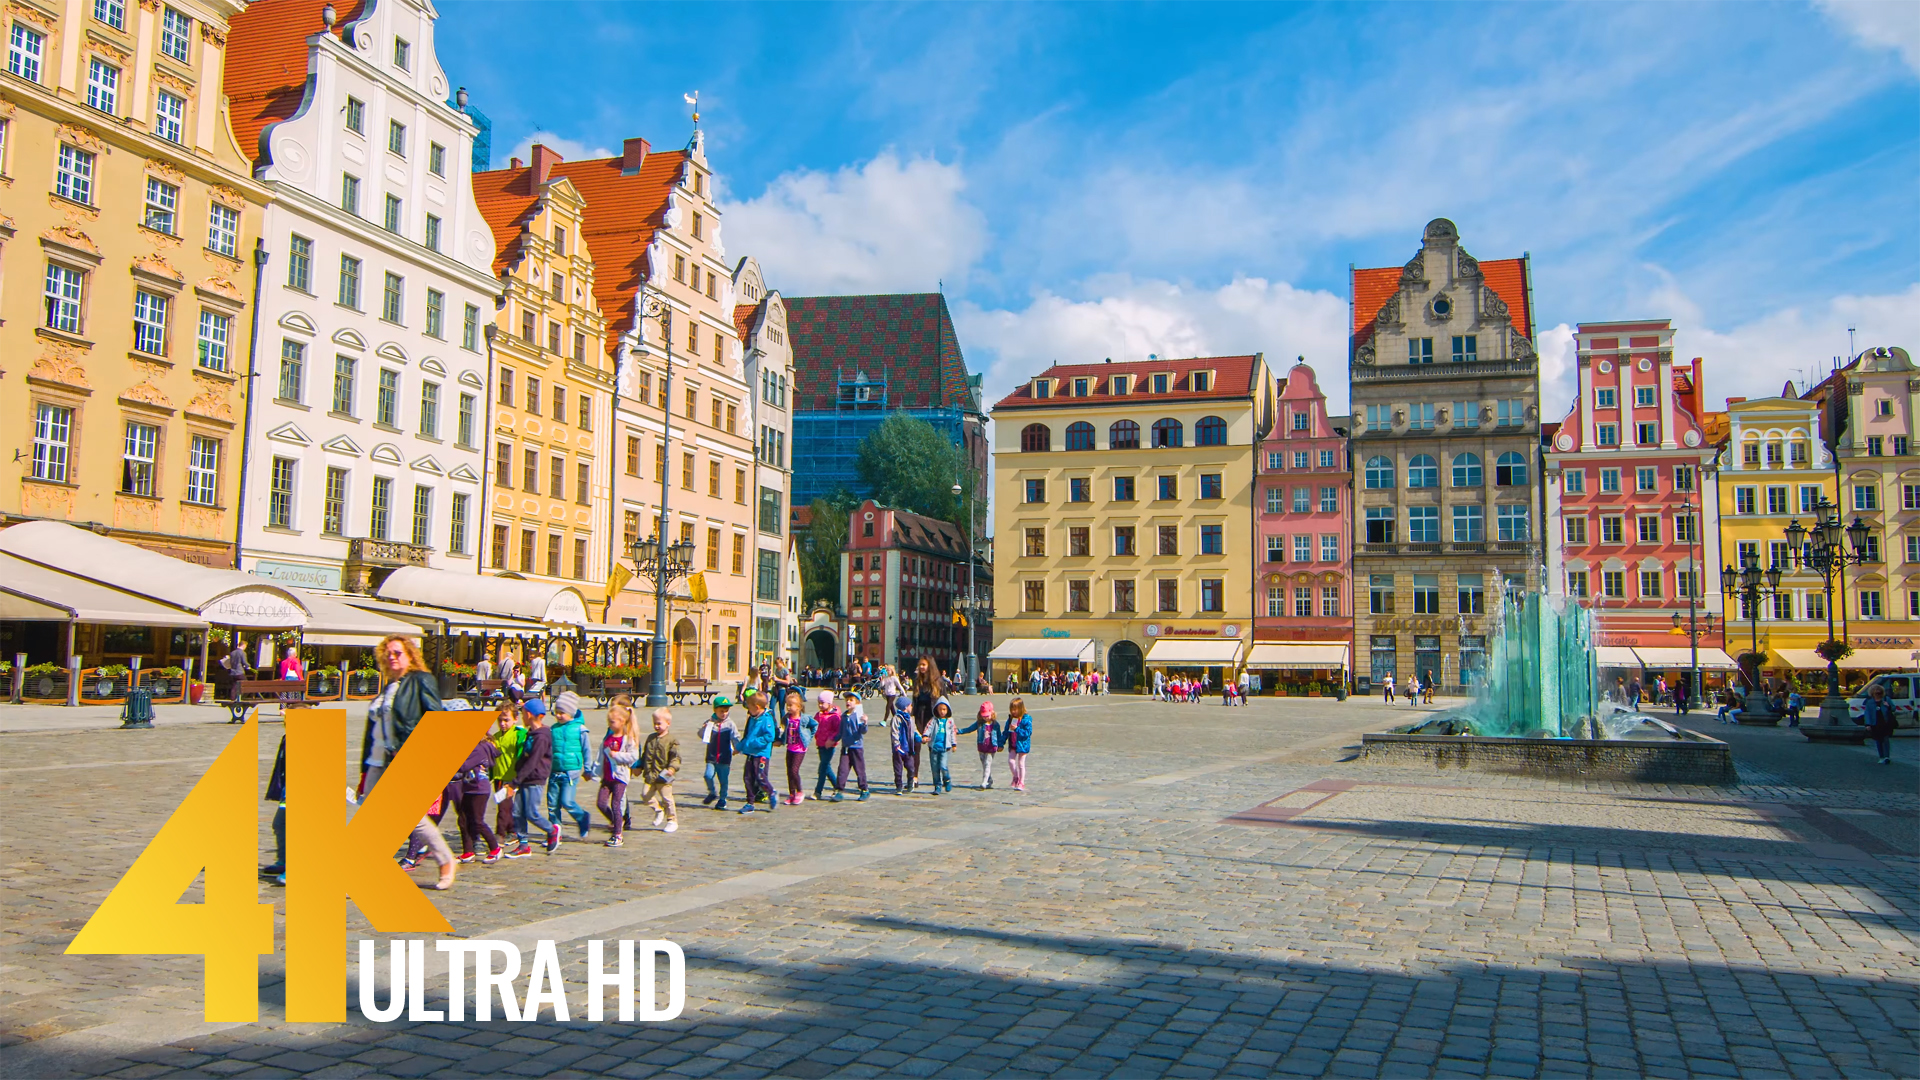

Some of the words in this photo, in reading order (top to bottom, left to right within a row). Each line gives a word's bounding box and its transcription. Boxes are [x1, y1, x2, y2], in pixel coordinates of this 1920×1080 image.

[271, 567, 327, 586] Lwowska
[219, 601, 254, 617] DWÓR
[258, 605, 292, 618] POLSKI
[719, 608, 737, 618] ANTYKI
[1164, 626, 1219, 636] Dominium
